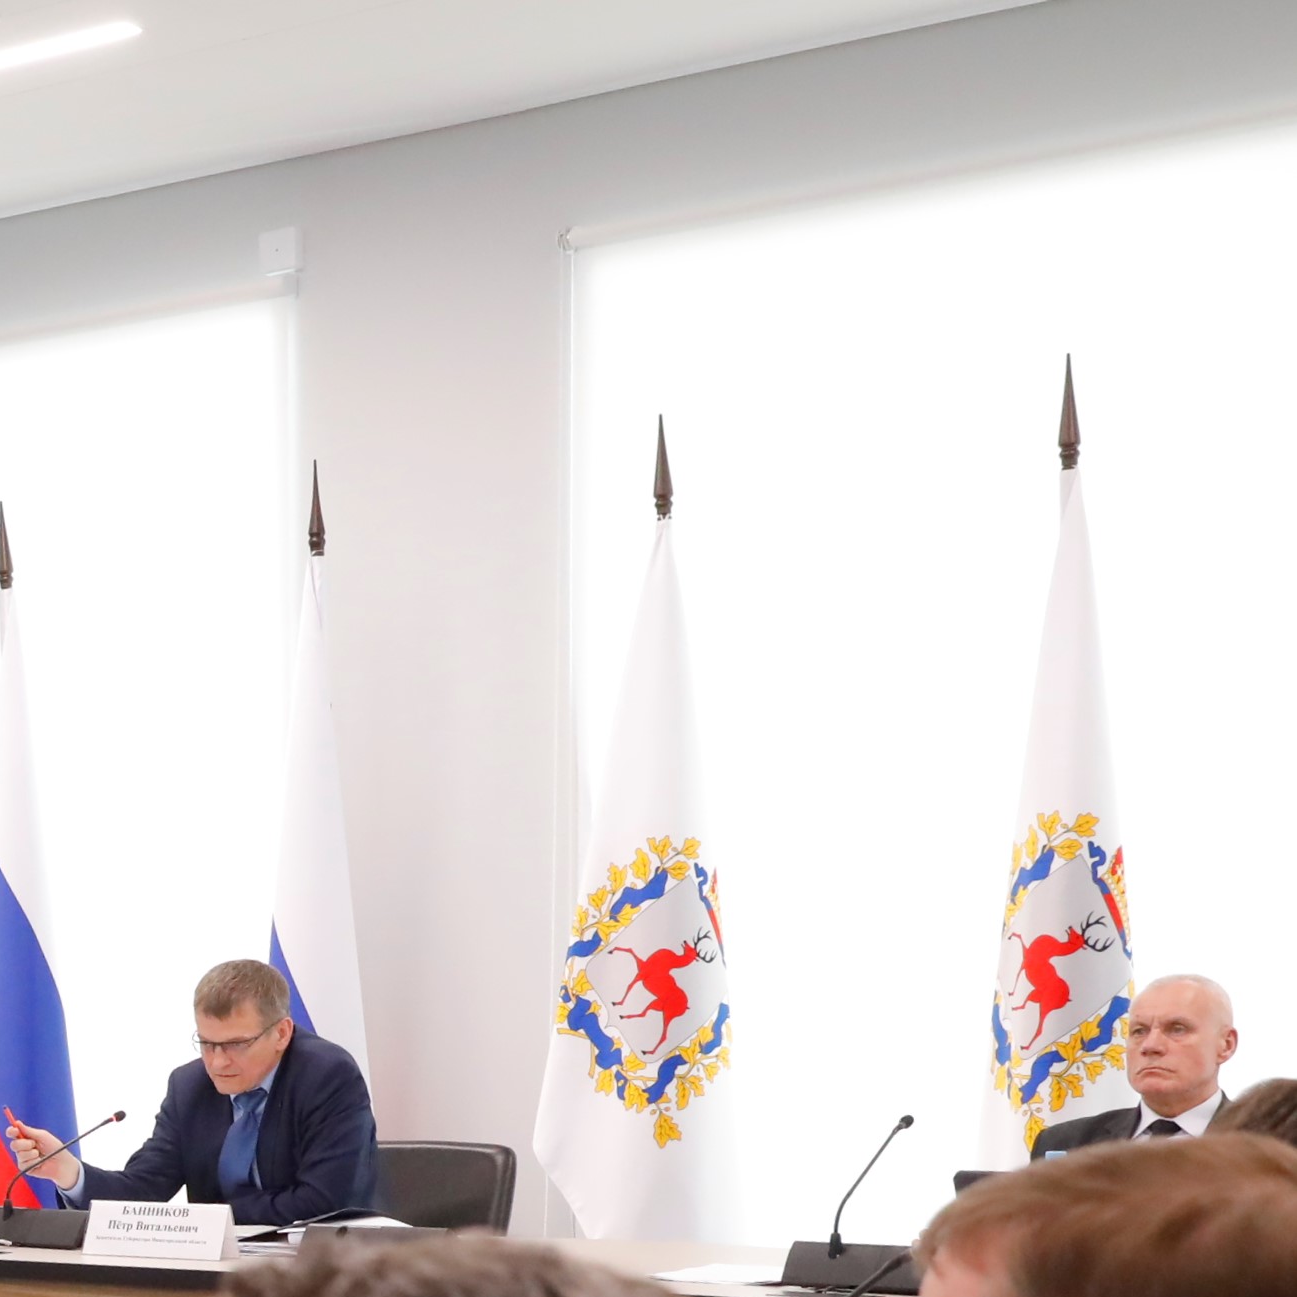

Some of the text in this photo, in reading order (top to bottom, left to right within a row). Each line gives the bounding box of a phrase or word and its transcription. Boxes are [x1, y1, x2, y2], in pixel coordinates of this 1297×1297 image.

[122, 1205, 190, 1218] БАННИКОВ
[107, 1219, 199, 1233] Пётр Витальевич
